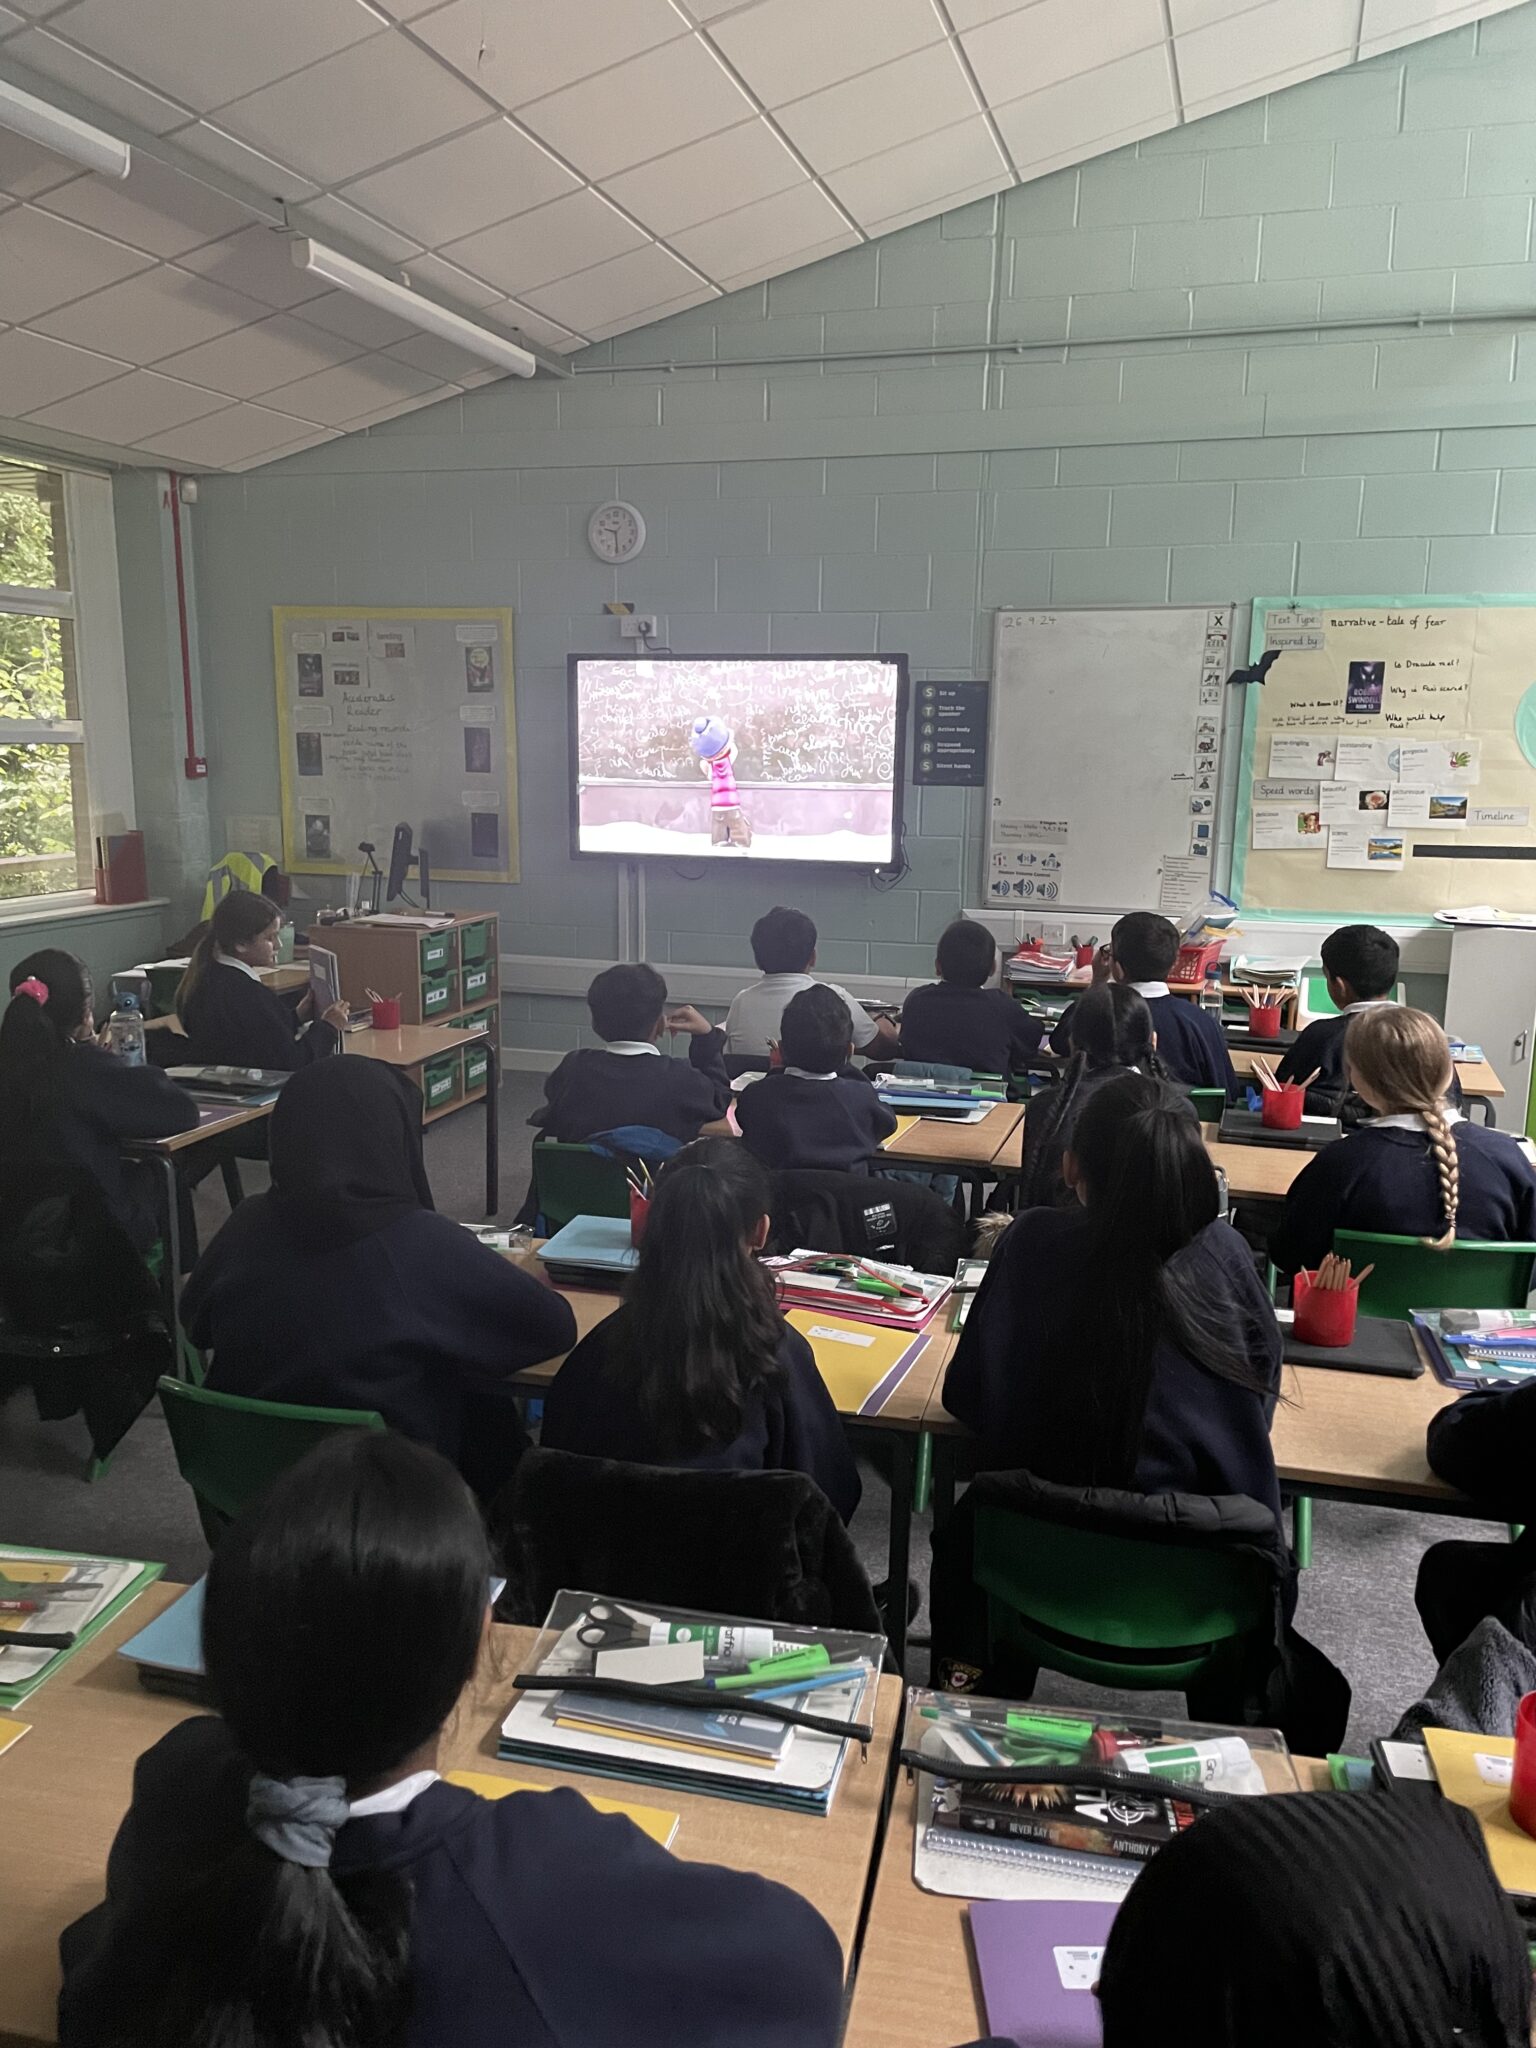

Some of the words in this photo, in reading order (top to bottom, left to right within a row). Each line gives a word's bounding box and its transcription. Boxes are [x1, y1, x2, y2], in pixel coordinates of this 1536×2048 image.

[1271, 613, 1291, 625] Text
[1295, 613, 1316, 628] Type
[1330, 617, 1377, 627] narrative
[1386, 615, 1405, 626] tale
[1409, 615, 1420, 630] of
[1424, 615, 1447, 630] fear
[1269, 633, 1304, 648] Inspired
[1306, 633, 1319, 649] by
[1390, 685, 1407, 698] Why
[1385, 713, 1402, 722] Who
[1407, 713, 1425, 721] will
[1259, 784, 1285, 797] Speed
[1288, 784, 1315, 796] words
[1474, 809, 1515, 821] Timeline
[1009, 1822, 1033, 1836] NEVER
[1033, 1825, 1048, 1839] SAY
[1112, 1839, 1151, 1856] ANTHONY
